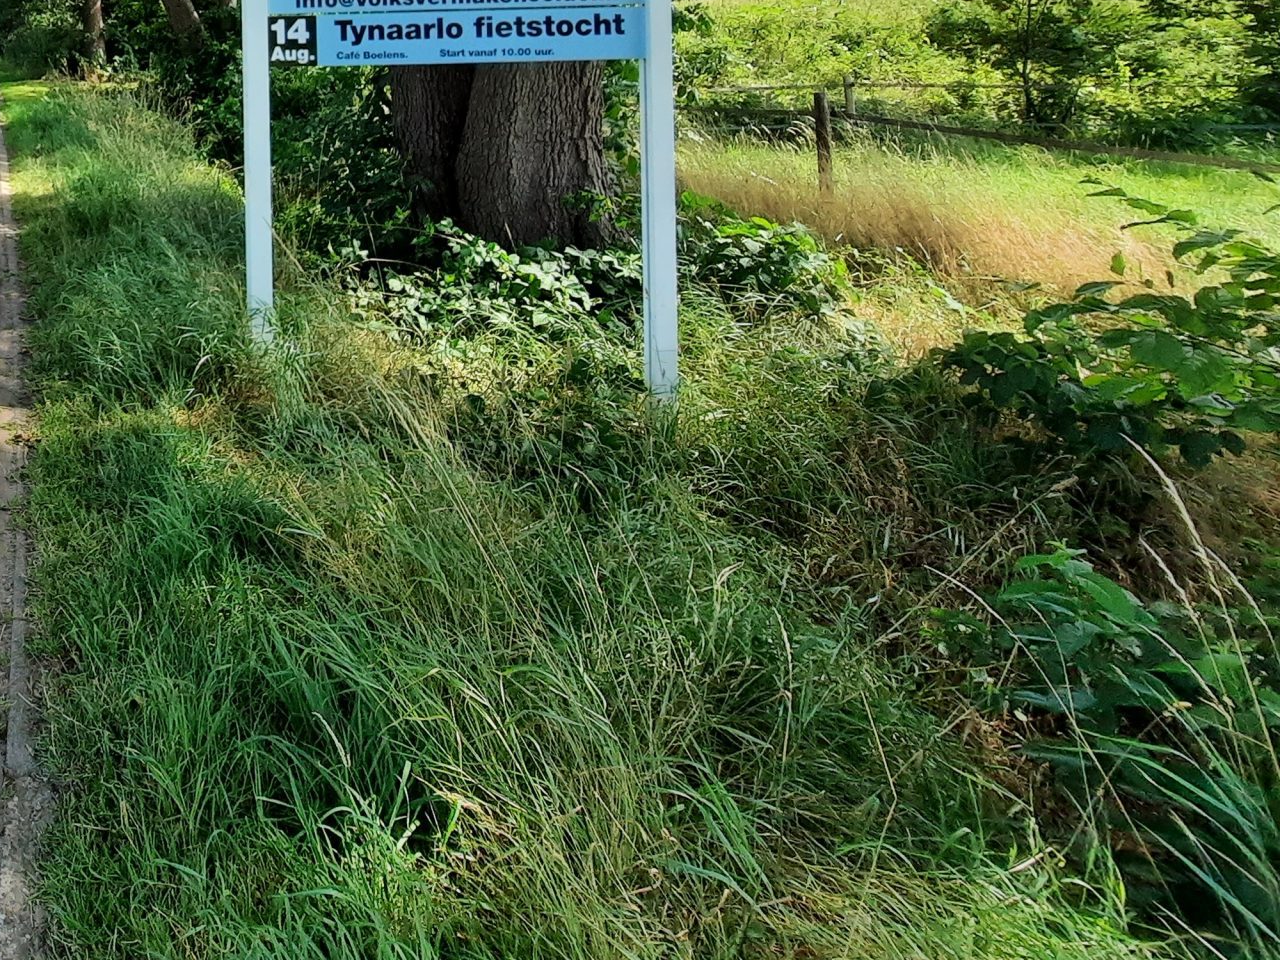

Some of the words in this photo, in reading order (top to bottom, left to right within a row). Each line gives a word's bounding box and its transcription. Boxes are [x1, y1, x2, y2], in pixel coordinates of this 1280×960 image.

[270, 18, 310, 45] 14
[334, 17, 464, 46] Tynaarlo
[473, 13, 626, 38] fietstocht
[270, 46, 316, 64] Aug.
[336, 49, 361, 60] Café
[363, 50, 408, 60] Boelens.
[439, 48, 466, 58] Start
[468, 47, 497, 58] vanaf
[501, 47, 531, 57] 10.00
[534, 47, 555, 57] uur.
